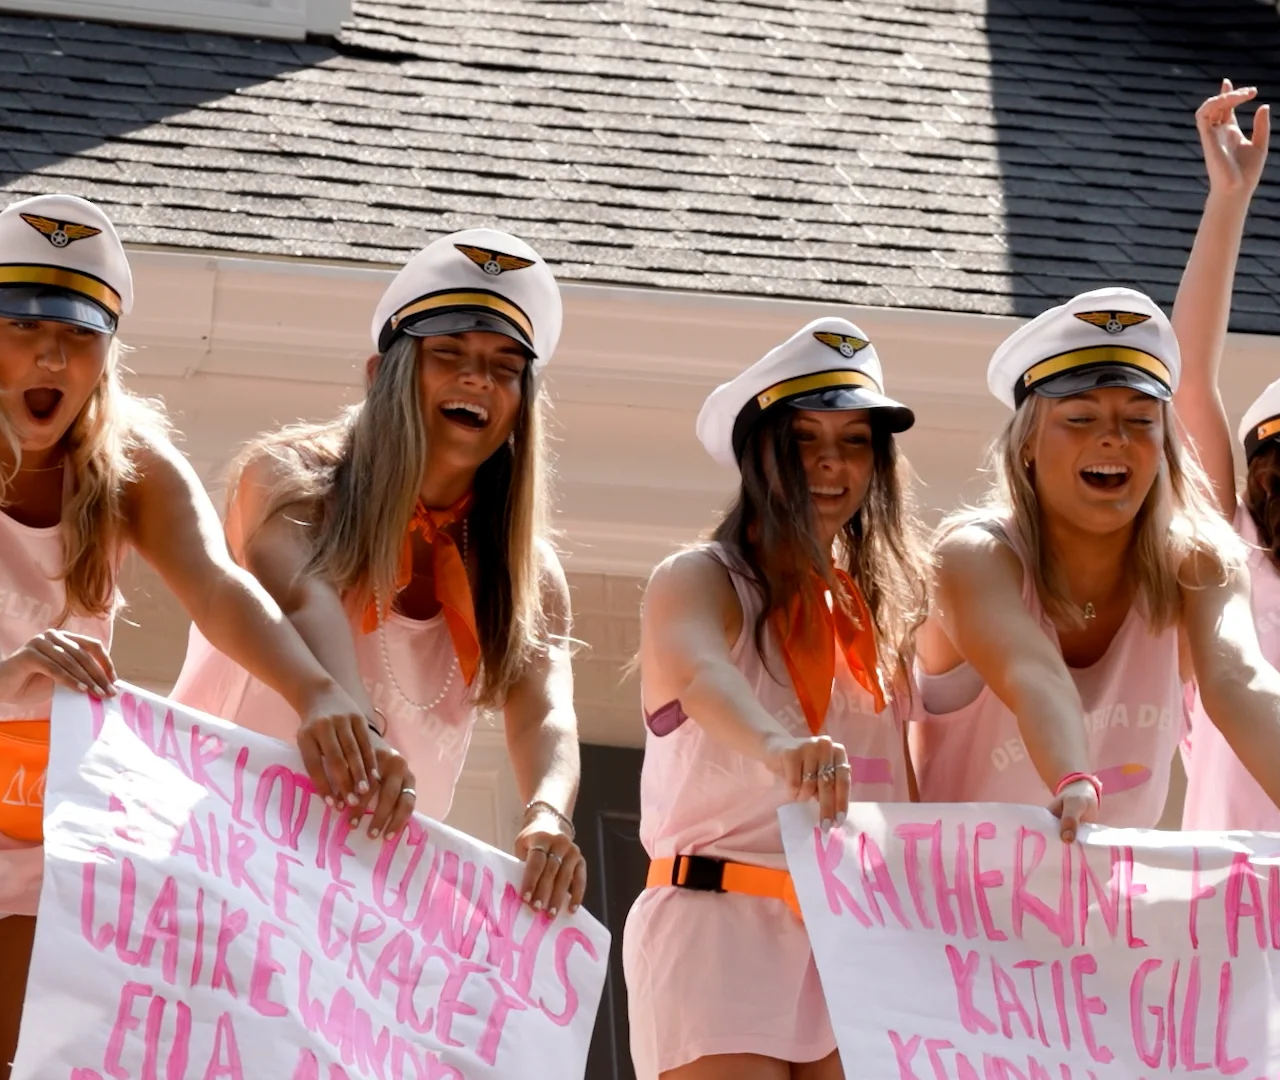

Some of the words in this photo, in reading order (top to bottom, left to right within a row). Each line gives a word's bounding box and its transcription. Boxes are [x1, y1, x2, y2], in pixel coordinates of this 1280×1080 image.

[80, 847, 288, 1018] CLAIRE
[814, 818, 1148, 949] KATHERINE
[944, 944, 1115, 1066] KATIE
[1130, 955, 1248, 1075] GILL
